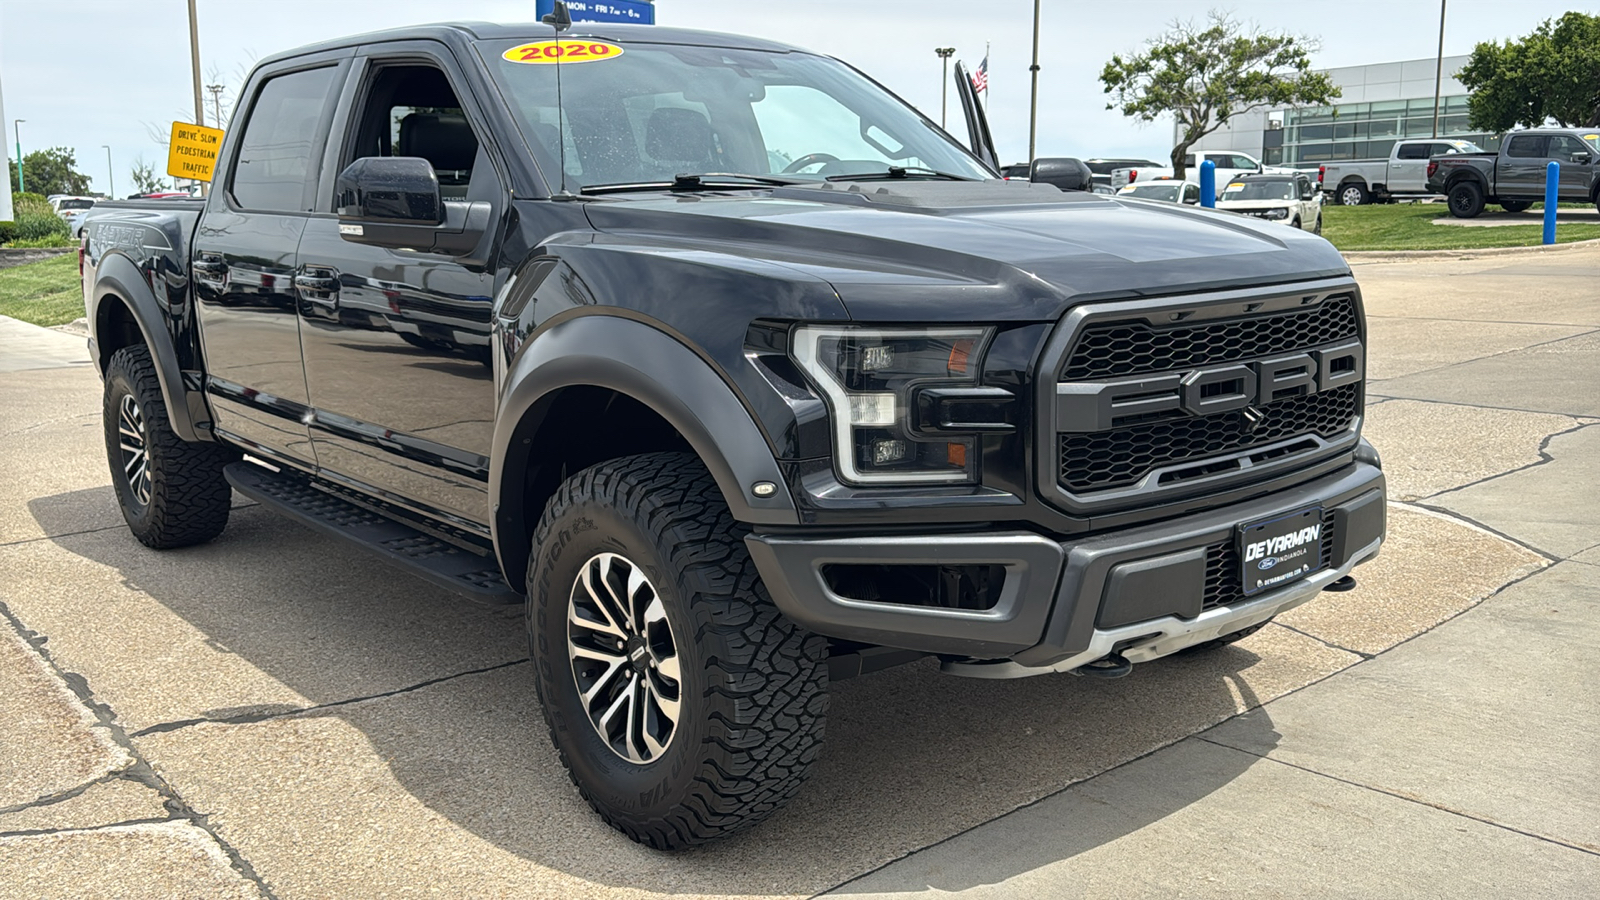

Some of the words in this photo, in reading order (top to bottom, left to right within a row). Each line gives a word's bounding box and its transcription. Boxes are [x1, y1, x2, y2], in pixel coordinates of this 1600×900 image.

[566, 2, 586, 11] MON
[595, 4, 608, 13] FRI
[519, 44, 609, 60] 2020
[178, 130, 198, 141] DRIVE
[200, 133, 217, 144] SLOW
[176, 145, 216, 159] PEDESTRIAN
[182, 162, 209, 174] TRAFFIC
[1057, 338, 1363, 432] FORD
[1245, 524, 1320, 562] DEYARMAN
[1277, 548, 1307, 562] INDIANOLA
